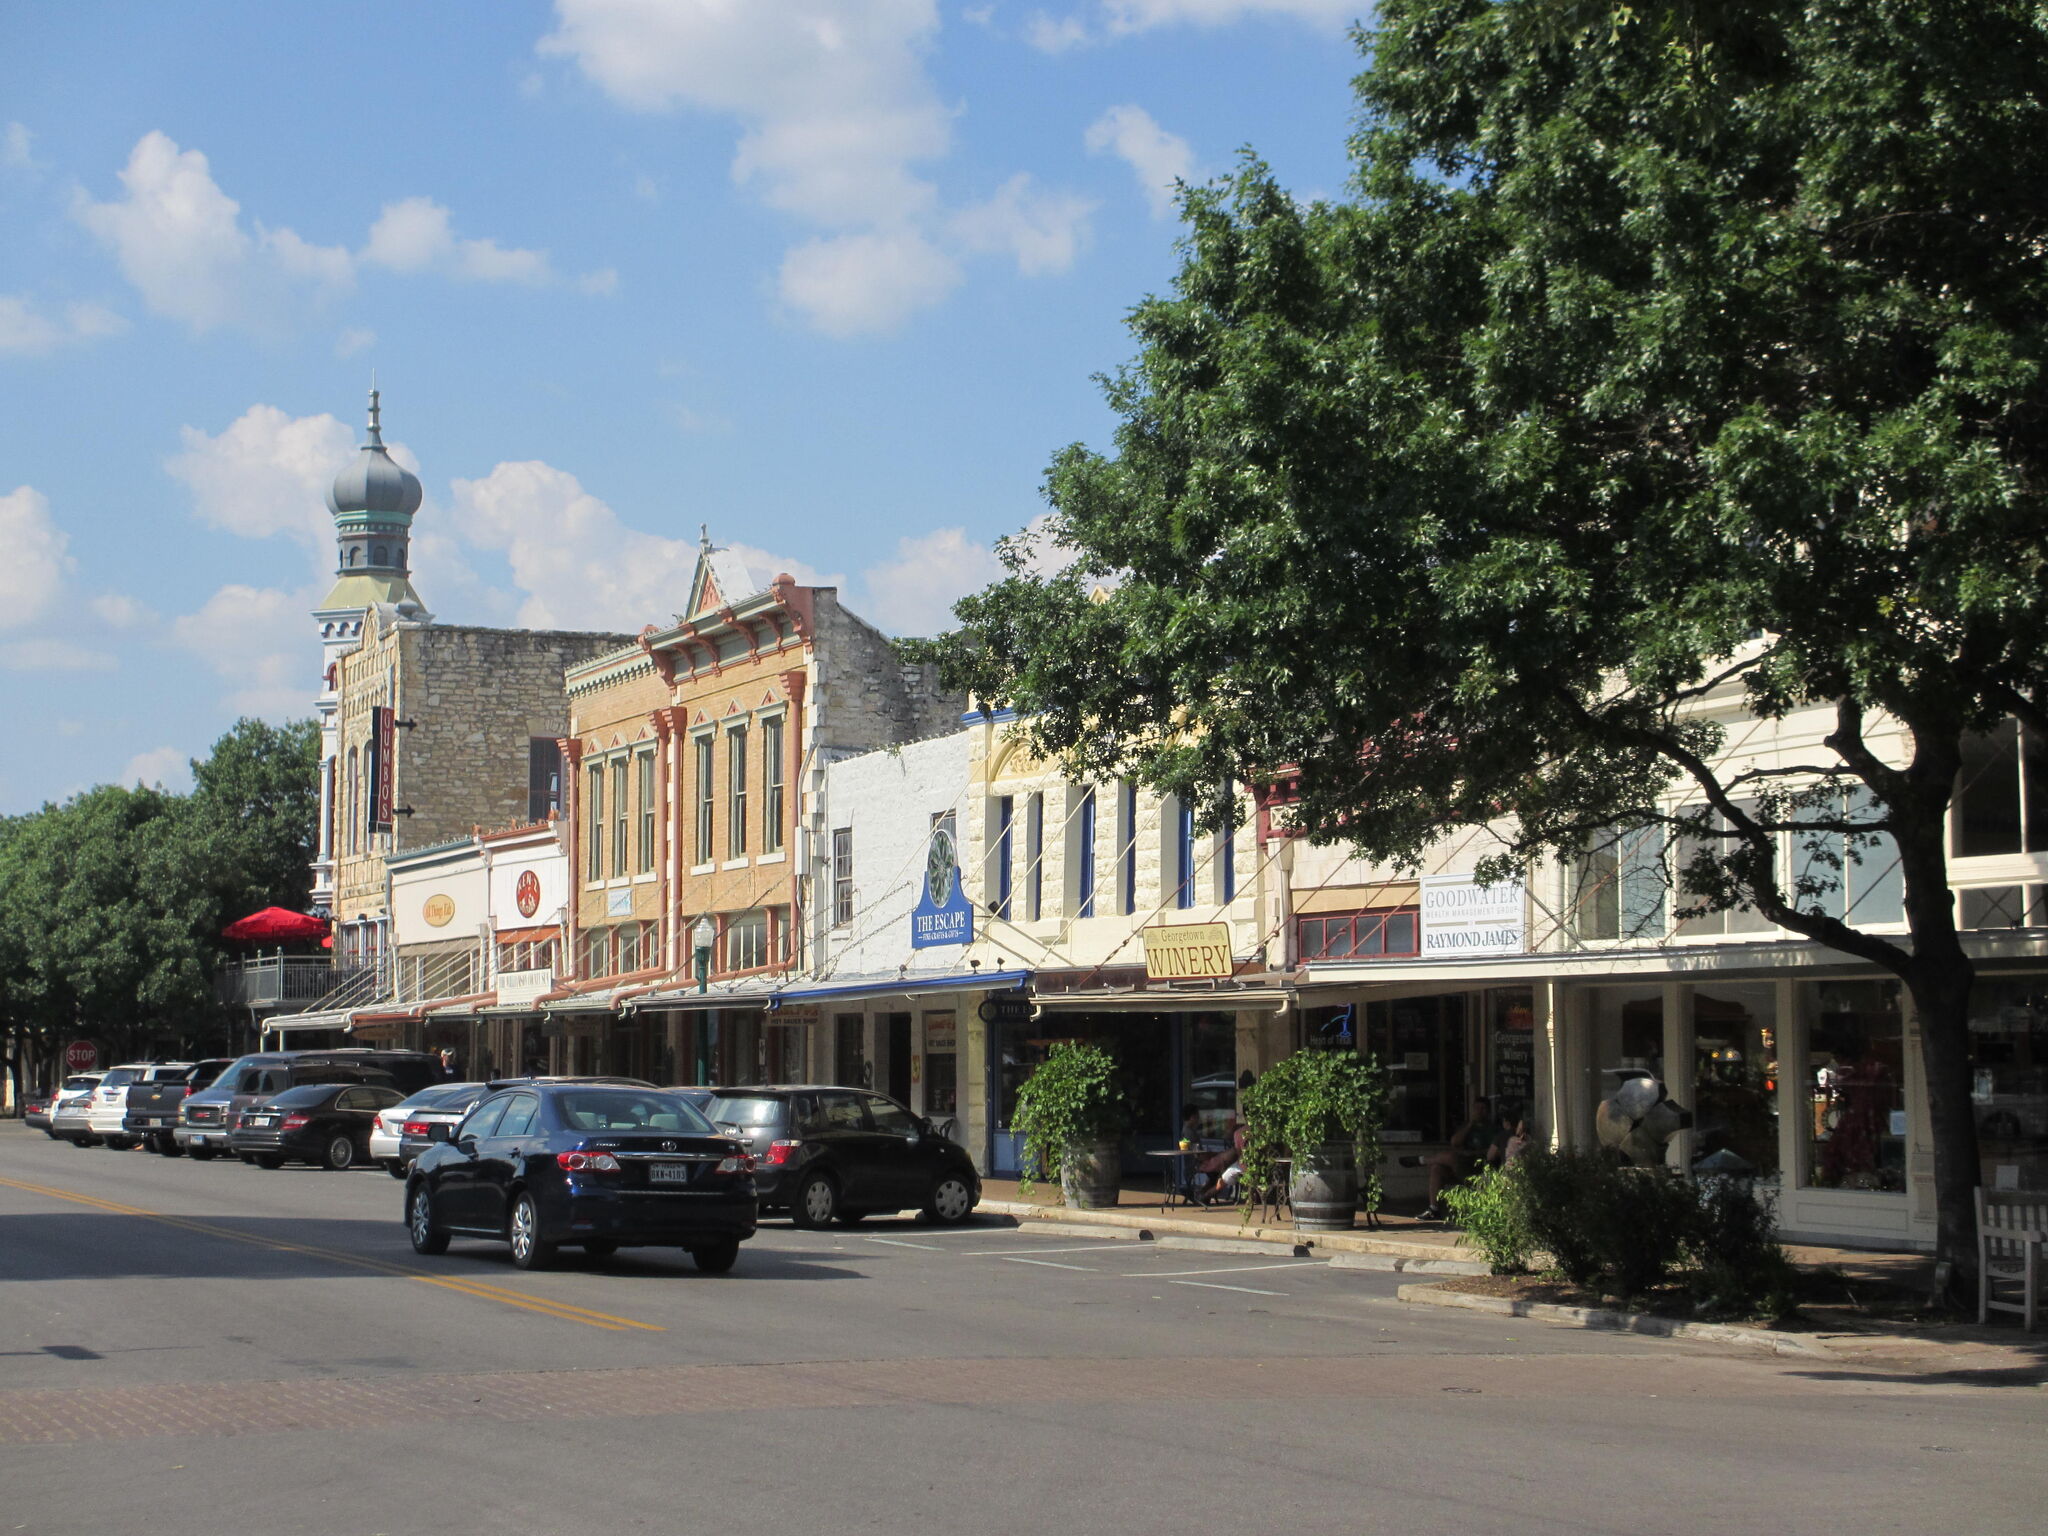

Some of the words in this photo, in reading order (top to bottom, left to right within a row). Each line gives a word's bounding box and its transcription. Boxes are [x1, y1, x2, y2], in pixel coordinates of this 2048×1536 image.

[1426, 886, 1518, 908] GOODWATER
[1426, 910, 1450, 919] WEALTH
[1452, 907, 1495, 917] MANAGEMENT
[1497, 905, 1518, 914] GROUP
[917, 915, 934, 932] THE
[935, 911, 965, 930] ESCAPE
[1161, 929, 1205, 944] Georgetown
[1427, 932, 1480, 948] RAYMOND
[1482, 930, 1518, 946] JAMES
[1146, 945, 1227, 976] WINERY
[1495, 1031, 1532, 1046] Georgetow
[69, 1050, 96, 1061] STOP
